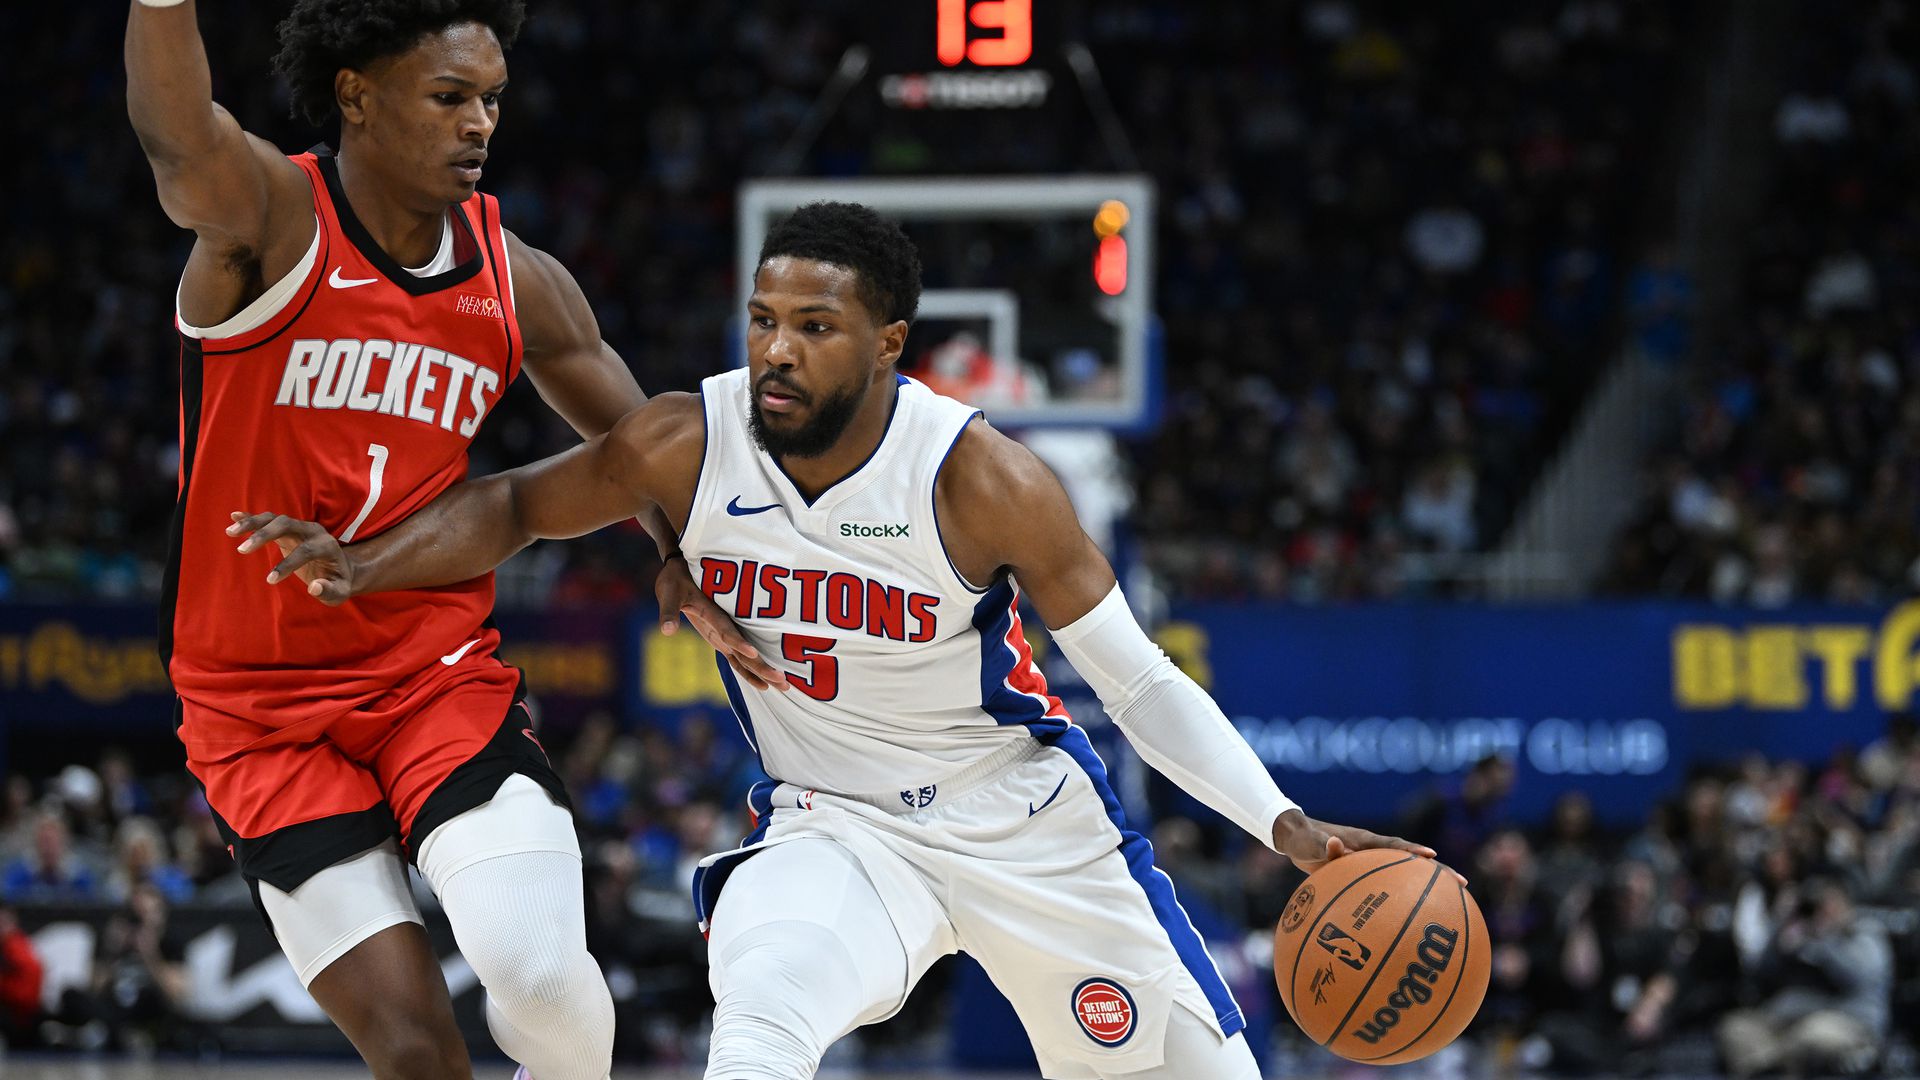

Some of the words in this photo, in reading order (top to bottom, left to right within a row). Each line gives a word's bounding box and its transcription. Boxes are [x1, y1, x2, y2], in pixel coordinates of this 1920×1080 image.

[274, 338, 499, 439] ROCKETS
[338, 443, 389, 543] 1
[840, 523, 910, 538] StockX
[700, 557, 941, 643] PISTONS
[781, 633, 839, 702] 5
[1083, 1000, 1121, 1013] DETROIT
[1086, 1012, 1125, 1024] PISTONS
[1352, 922, 1459, 1044] Wilson
